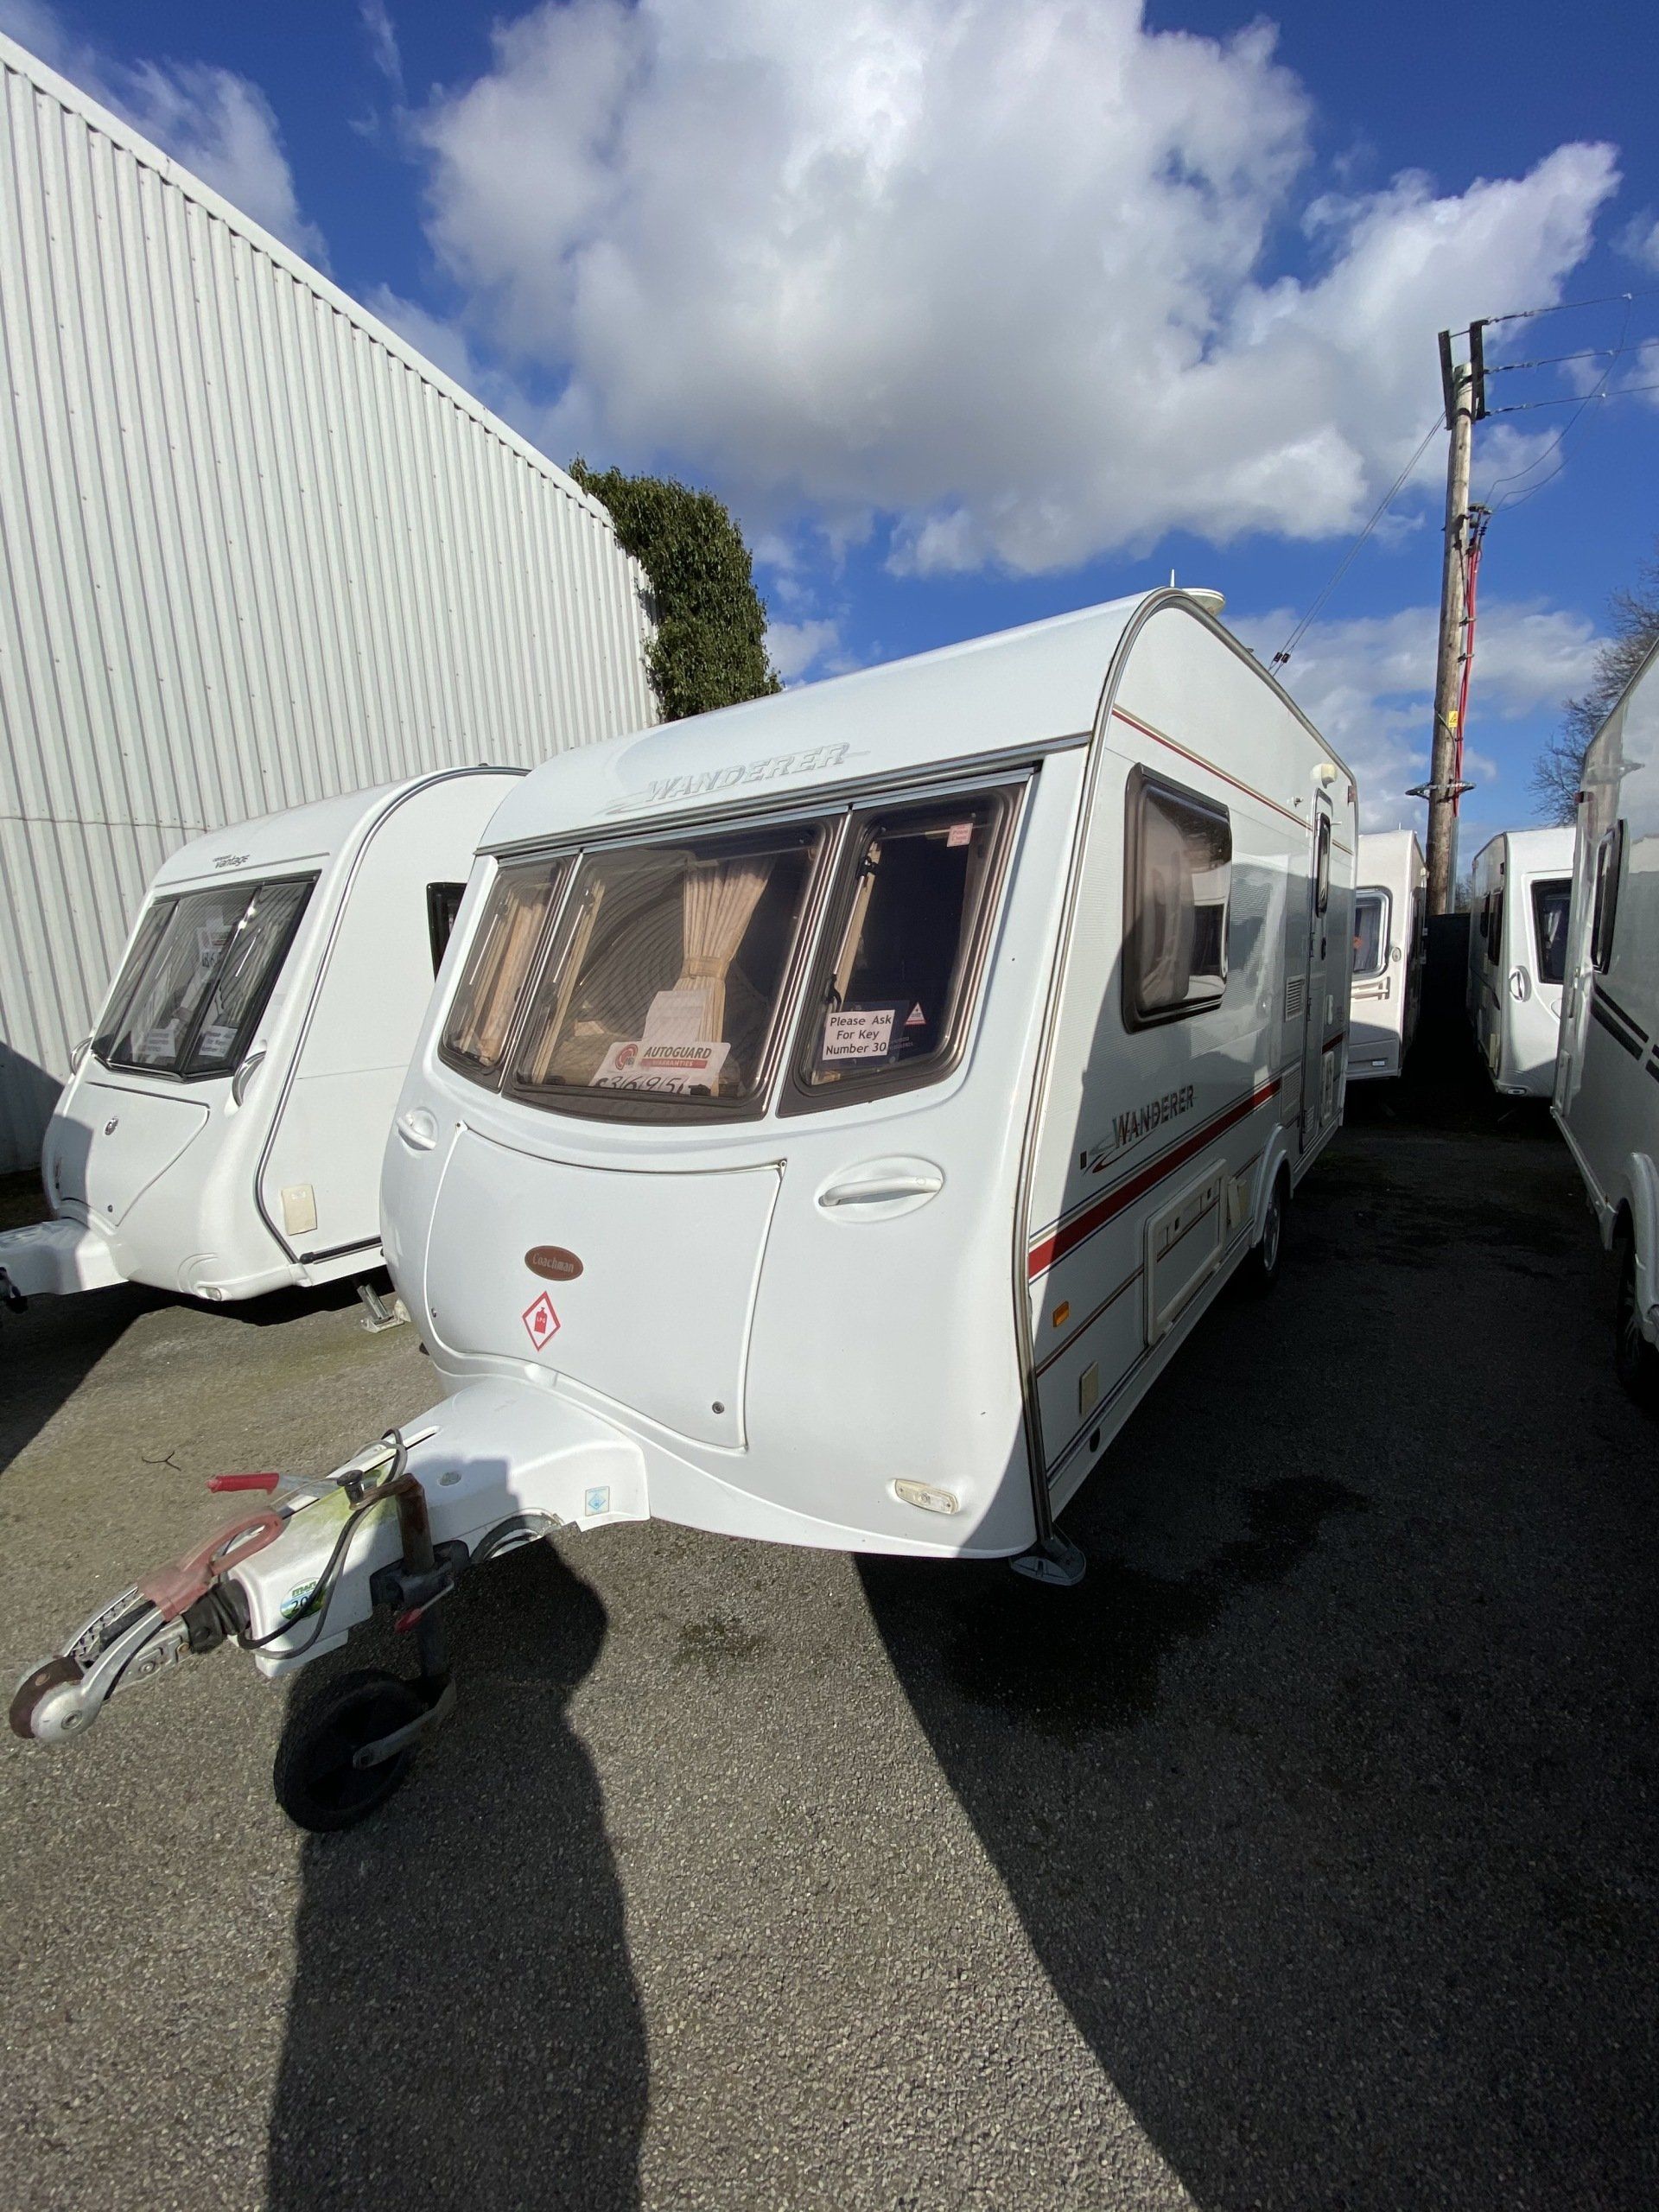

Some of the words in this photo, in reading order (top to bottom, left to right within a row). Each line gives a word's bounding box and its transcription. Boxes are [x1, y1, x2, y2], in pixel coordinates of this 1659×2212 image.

[646, 742, 850, 802] WANDERER
[830, 1017, 866, 1027] Please
[872, 1014, 892, 1025] Ask
[836, 1030, 855, 1040] For
[858, 1030, 880, 1041] Key
[644, 1046, 712, 1059] AUTOGUARD
[826, 1044, 869, 1055] Number
[872, 1042, 887, 1052] 30
[652, 1059, 694, 1068] WARRANTIES
[1112, 1084, 1194, 1149] WANDERER
[532, 1252, 575, 1273] Coachman
